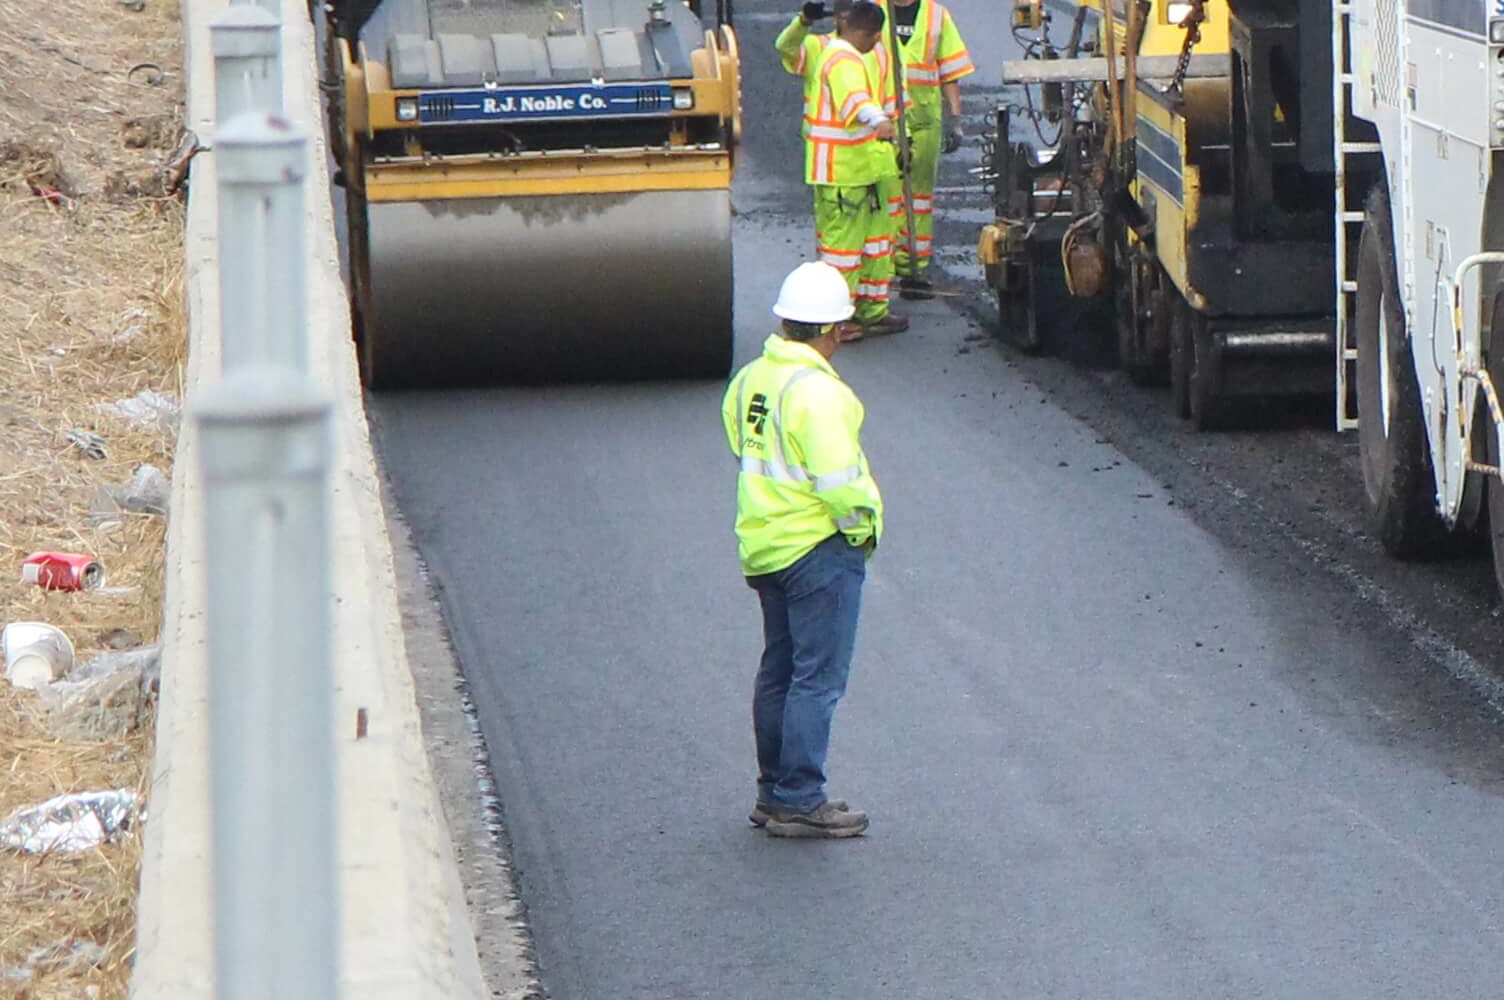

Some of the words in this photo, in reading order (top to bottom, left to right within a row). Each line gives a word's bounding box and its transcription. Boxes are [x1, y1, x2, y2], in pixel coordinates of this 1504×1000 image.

[484, 97, 517, 113] R.J.
[521, 96, 573, 112] Noble
[579, 93, 607, 109] Co.
